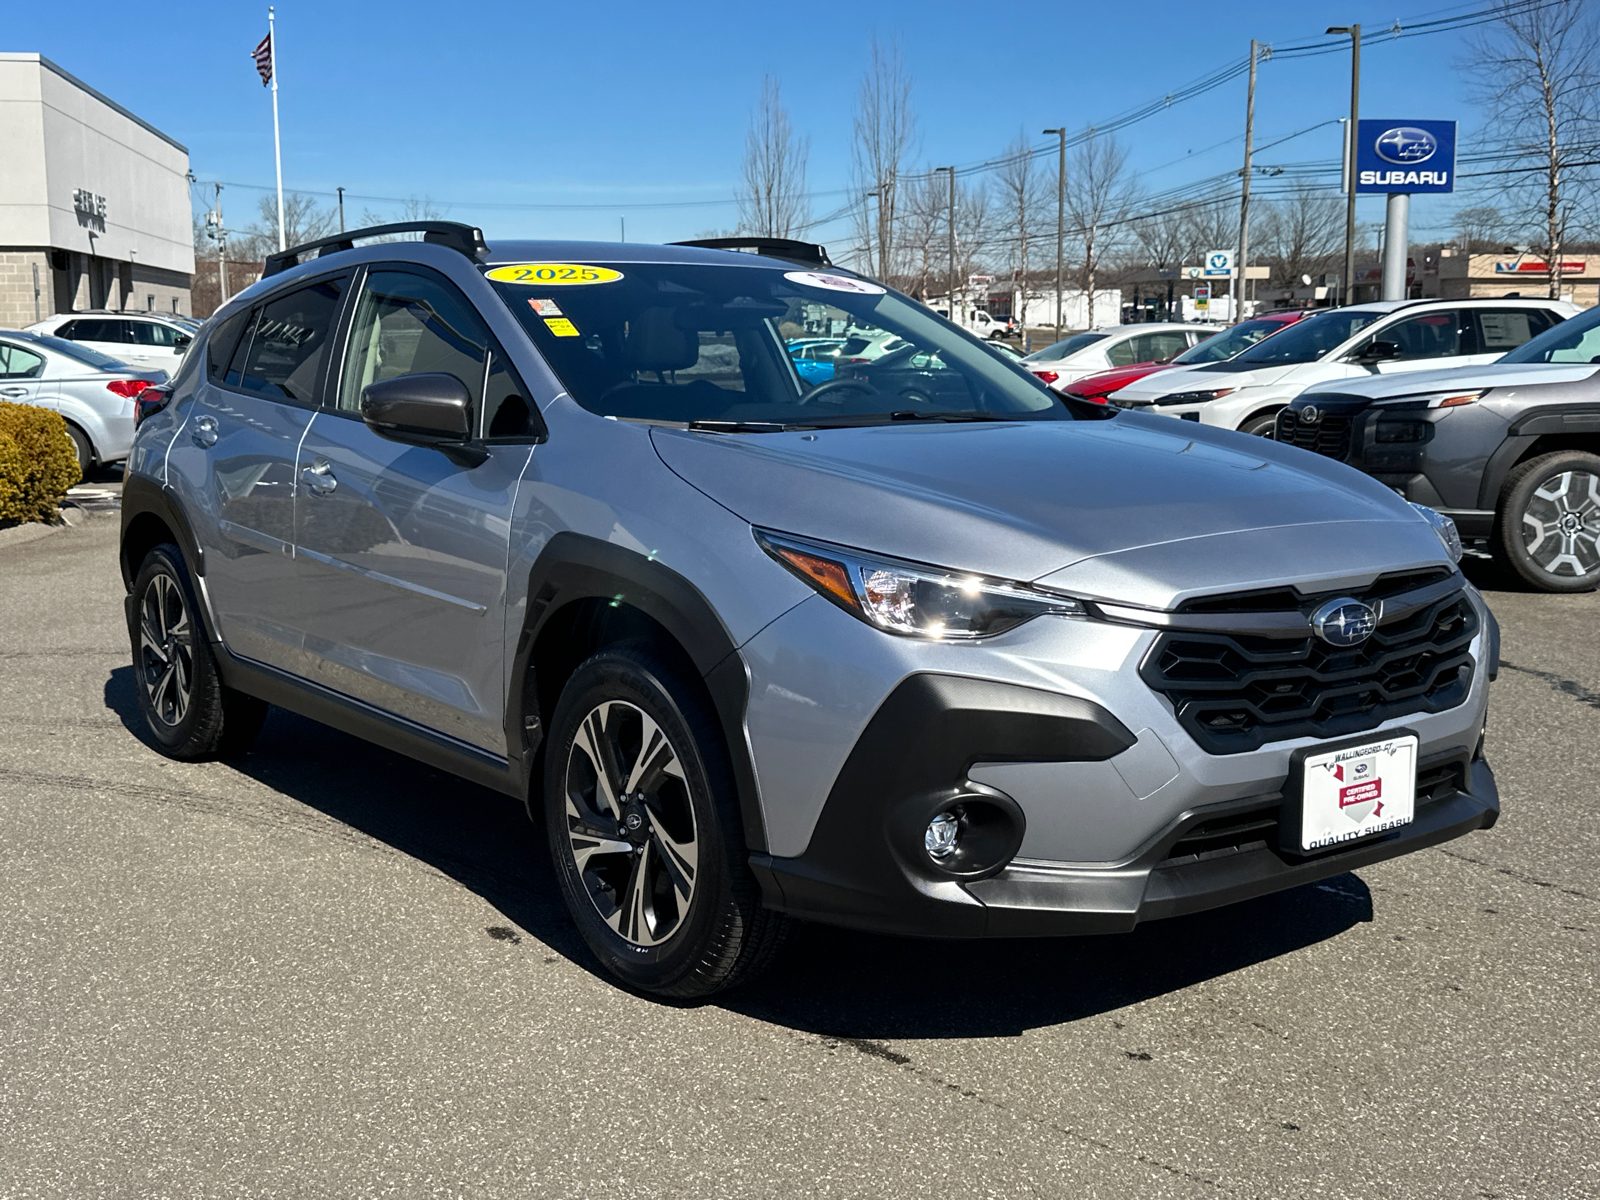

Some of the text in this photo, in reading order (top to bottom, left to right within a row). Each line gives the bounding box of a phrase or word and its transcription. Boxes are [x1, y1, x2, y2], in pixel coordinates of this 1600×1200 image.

[1360, 171, 1447, 185] SUBARU
[514, 268, 600, 281] 2025
[1346, 783, 1376, 796] CERTIFIED
[1343, 790, 1378, 804] PRE-OWNED
[1309, 816, 1412, 850] QUALITY SUBARU
